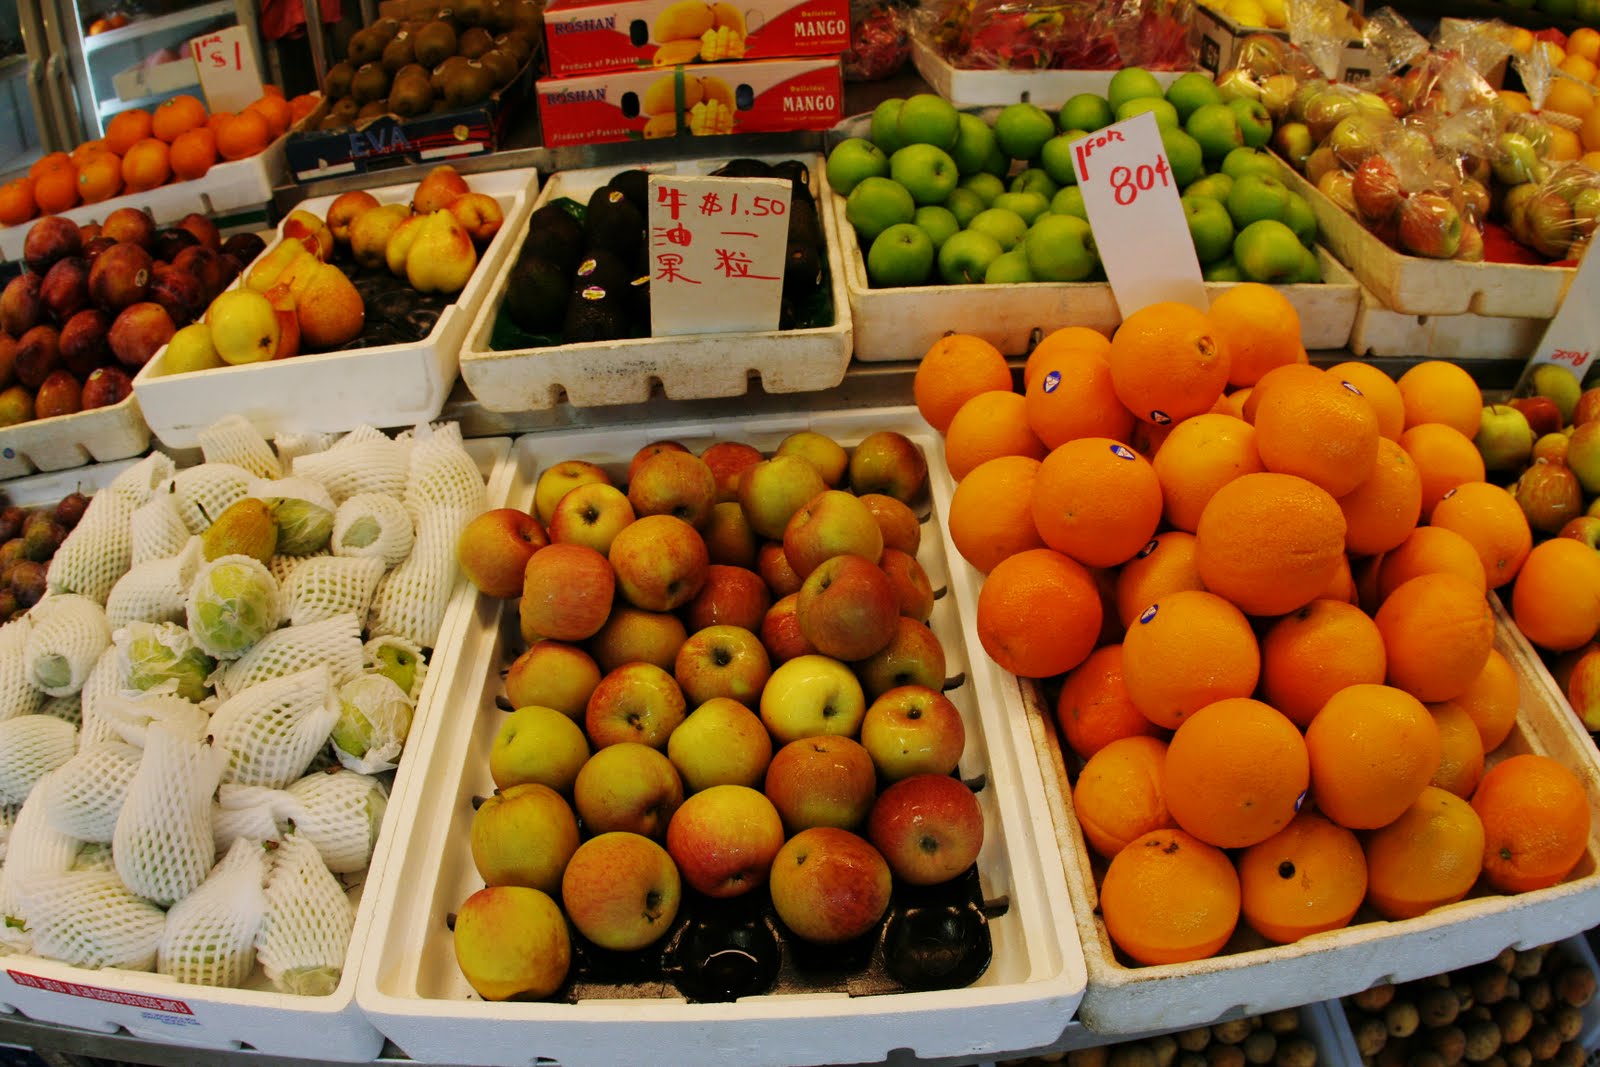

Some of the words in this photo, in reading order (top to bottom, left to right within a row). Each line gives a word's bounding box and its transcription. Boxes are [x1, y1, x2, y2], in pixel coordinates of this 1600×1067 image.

[554, 16, 616, 35] ROSHAN
[794, 19, 846, 38] MANGO
[560, 62, 592, 71] Produce
[605, 56, 640, 66] Pakistan
[546, 88, 607, 105] ROSHAN
[783, 95, 835, 112] MANGO
[597, 128, 630, 136] Pakistan
[349, 126, 411, 157] EVA
[698, 192, 786, 216] $1.50
